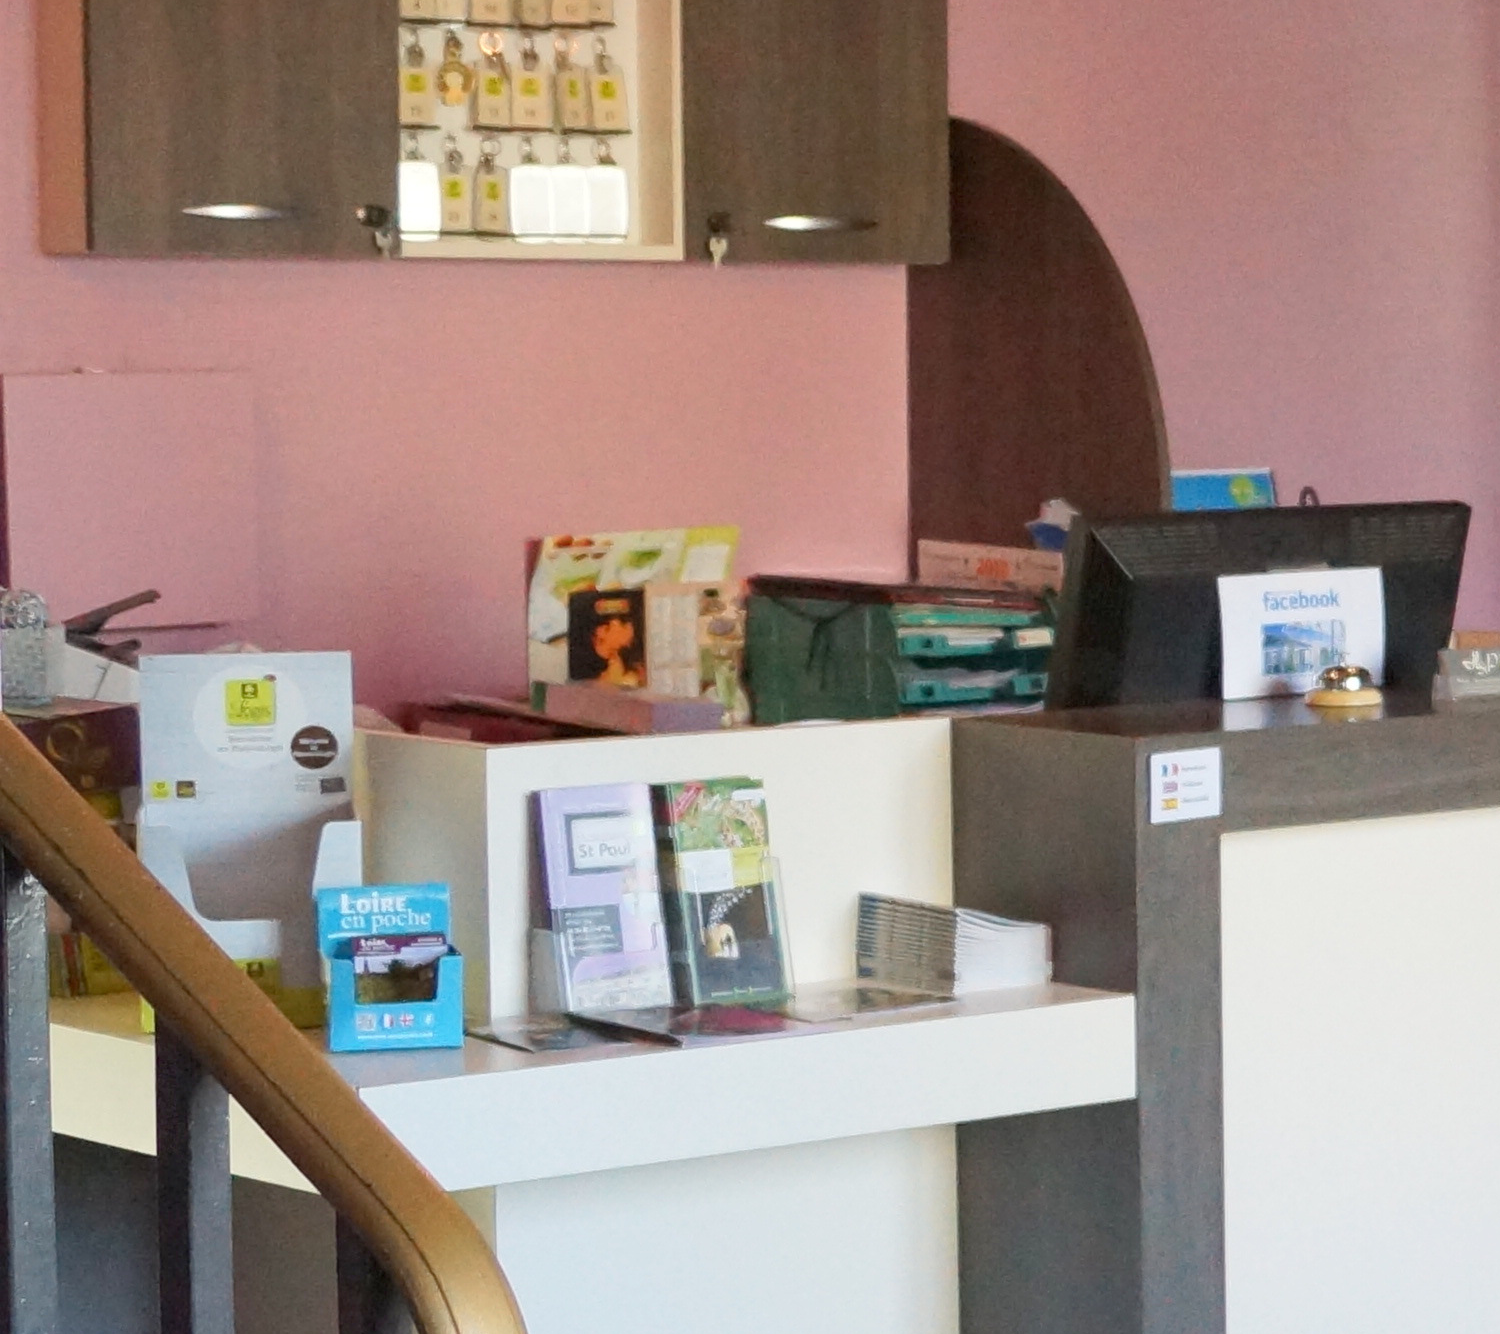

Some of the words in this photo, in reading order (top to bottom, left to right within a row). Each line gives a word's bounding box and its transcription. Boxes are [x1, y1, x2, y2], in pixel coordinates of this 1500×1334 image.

[1261, 588, 1340, 612] facebook
[577, 843, 595, 860] St
[340, 914, 366, 929] en
[370, 908, 432, 934] poche
